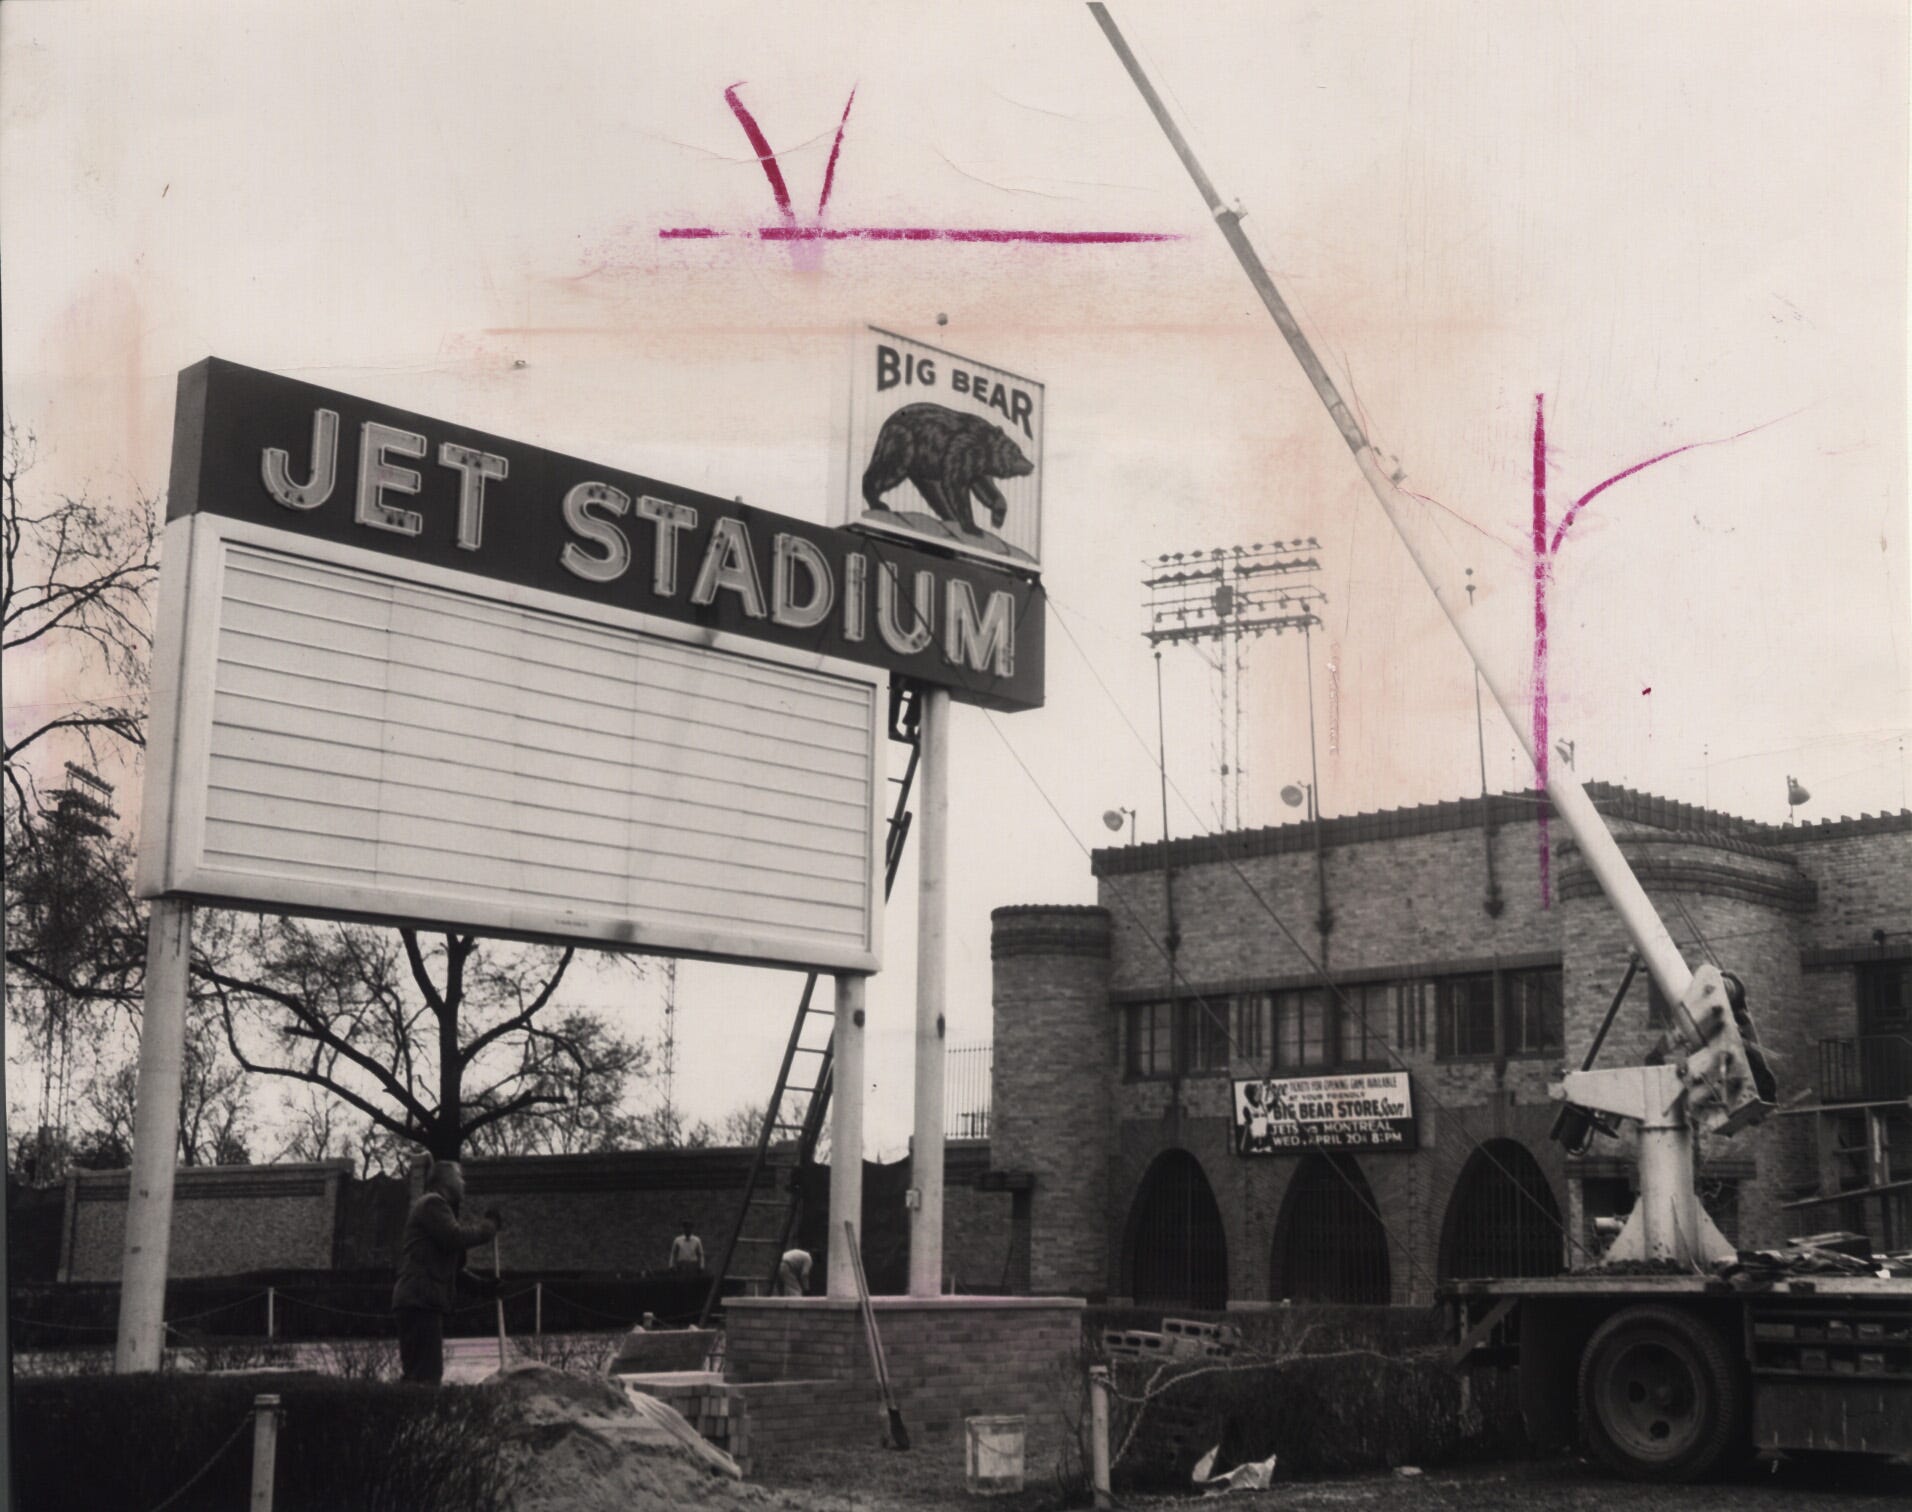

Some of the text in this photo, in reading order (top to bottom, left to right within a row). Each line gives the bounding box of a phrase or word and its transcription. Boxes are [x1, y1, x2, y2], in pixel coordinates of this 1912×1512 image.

[877, 344, 1034, 441] BIG BEAR
[261, 408, 1015, 677] JET STADIUM
[1302, 1093, 1323, 1101] YOUR
[1327, 1091, 1365, 1099] FRIENDLY
[1273, 1102, 1296, 1120] BIG
[1299, 1101, 1334, 1119] BEAR
[1271, 1123, 1299, 1135] JETS
[1323, 1120, 1394, 1133] MONTREAL
[1309, 1134, 1342, 1145] APRIL
